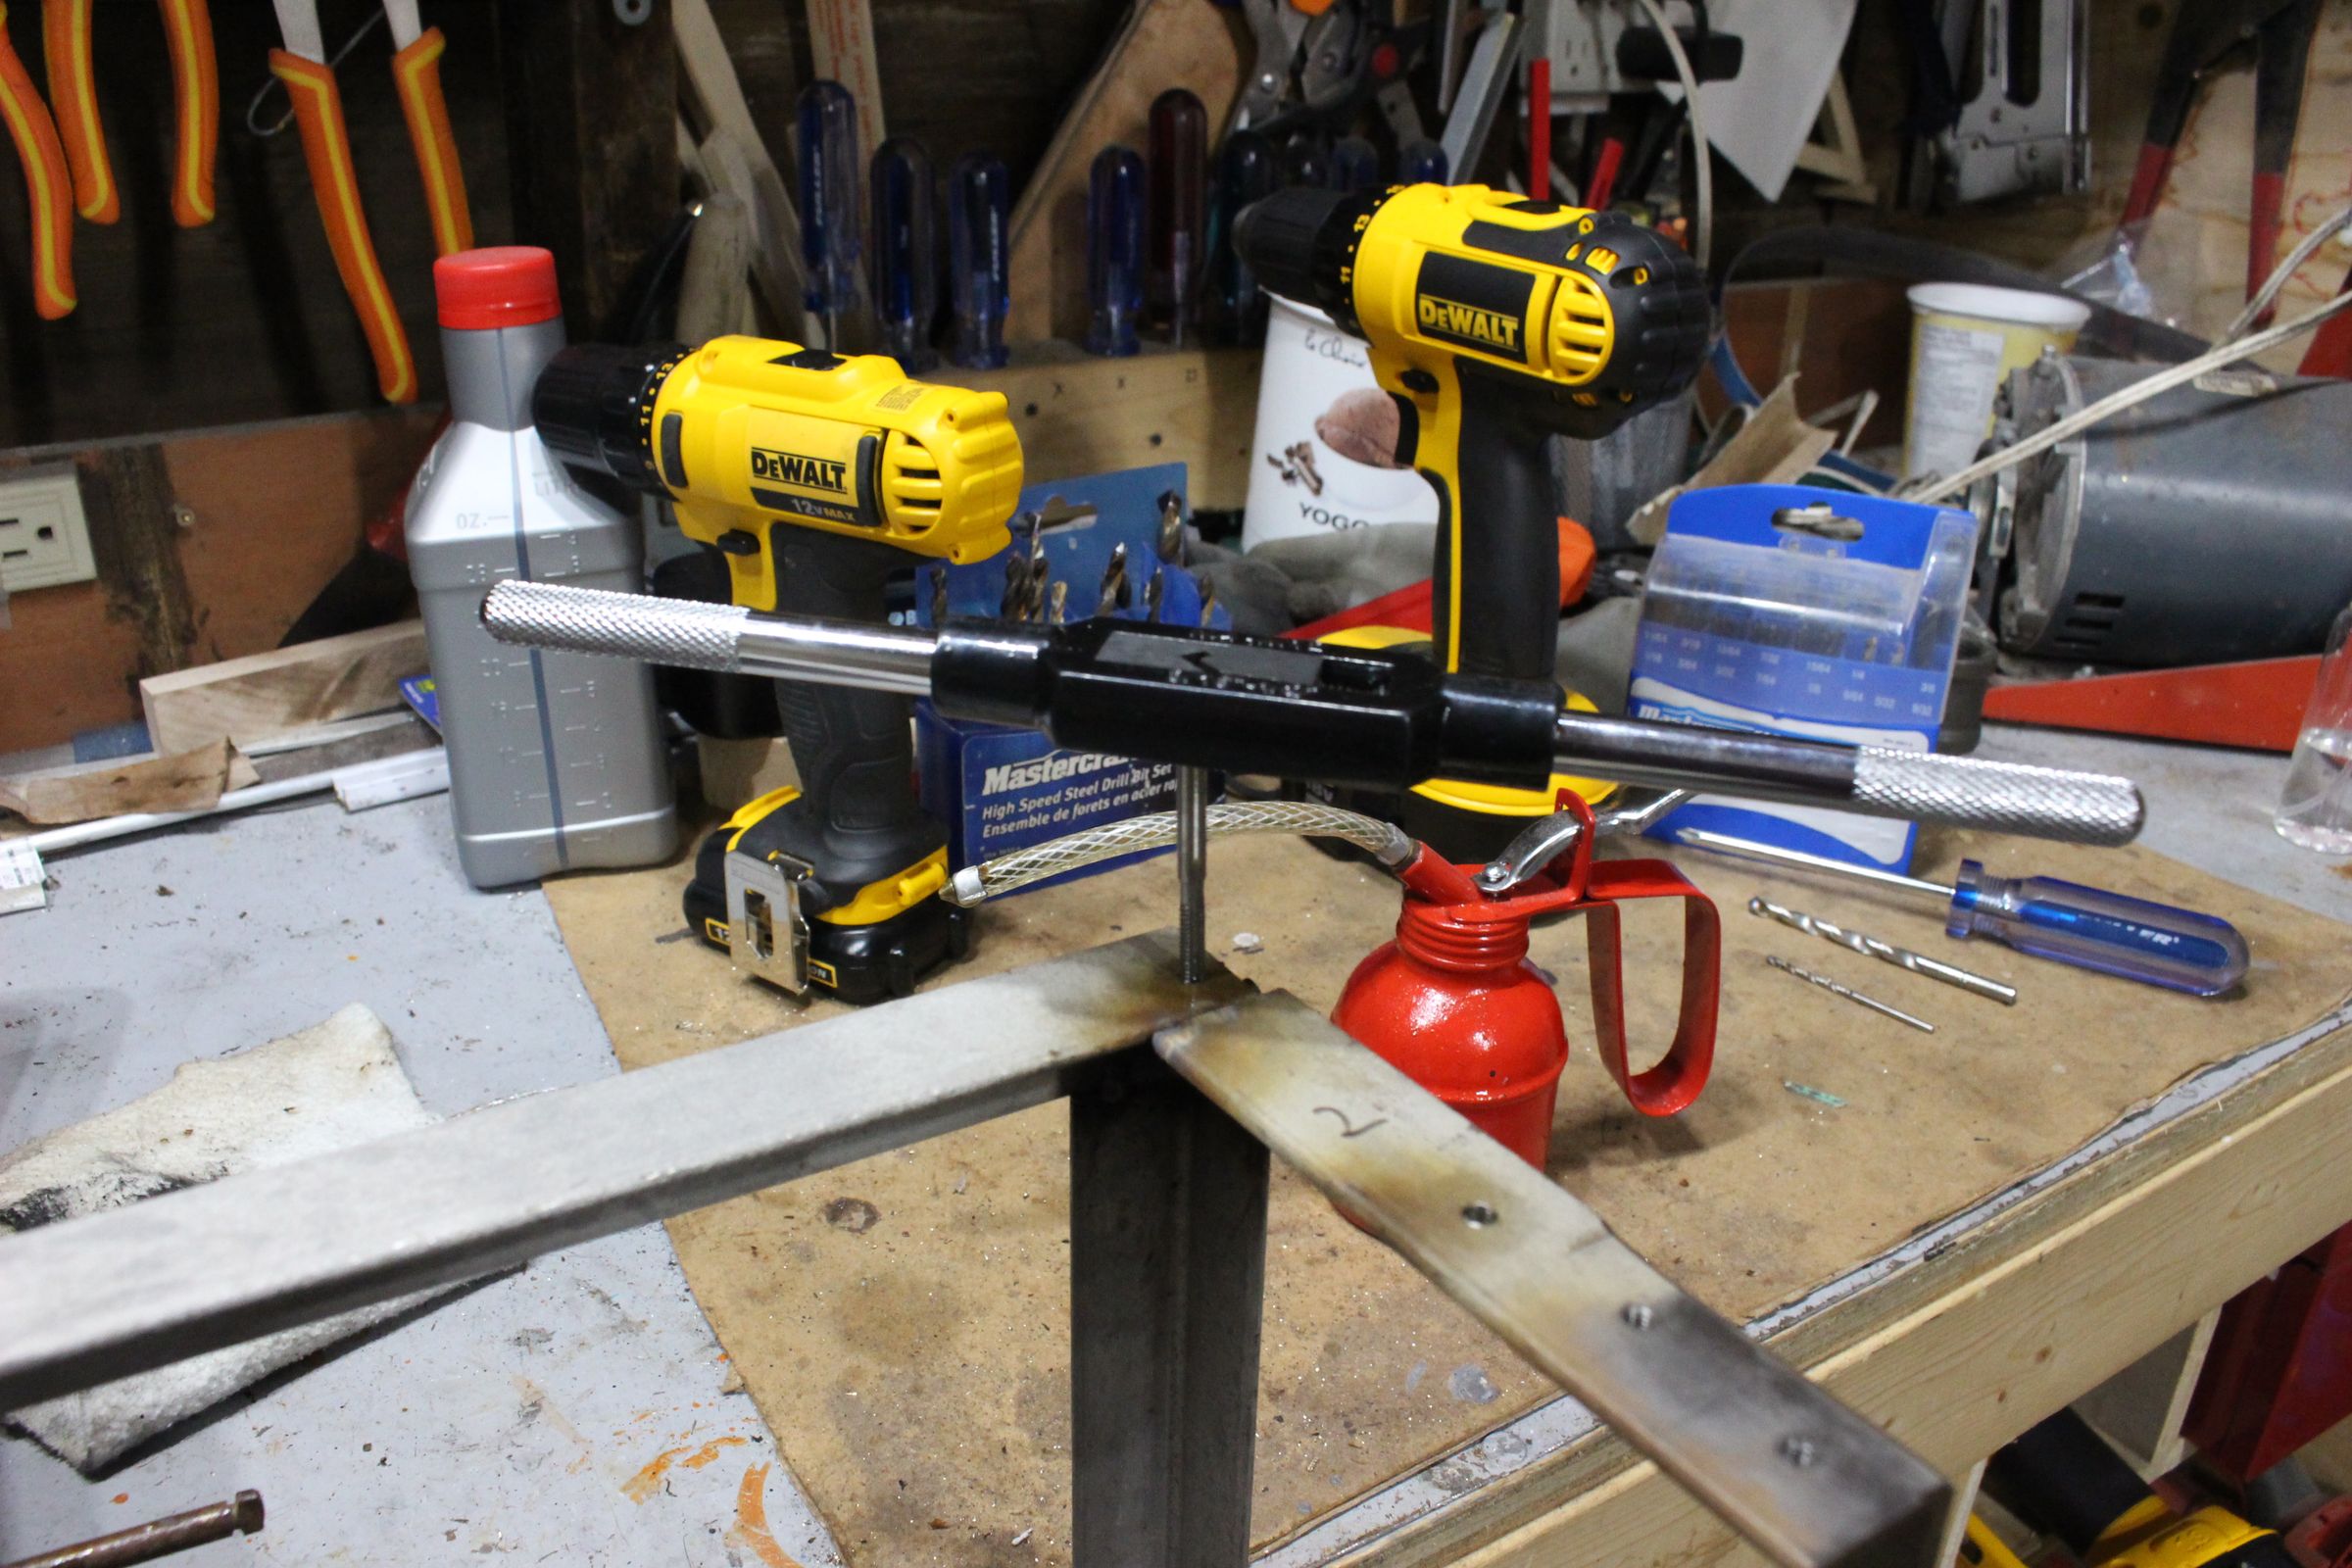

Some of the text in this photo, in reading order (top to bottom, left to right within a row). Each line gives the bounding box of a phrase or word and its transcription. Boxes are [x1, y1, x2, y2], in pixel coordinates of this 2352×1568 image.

[982, 754, 1138, 797] Mastercra
[982, 802, 1015, 821] High
[1018, 790, 1062, 813] Speed
[1064, 780, 1100, 802] Steel
[1102, 772, 1130, 792] Drill
[983, 812, 1051, 839] Ensemble
[1053, 808, 1070, 822] de
[1072, 798, 1110, 820] forets
[1112, 794, 1130, 807] en
